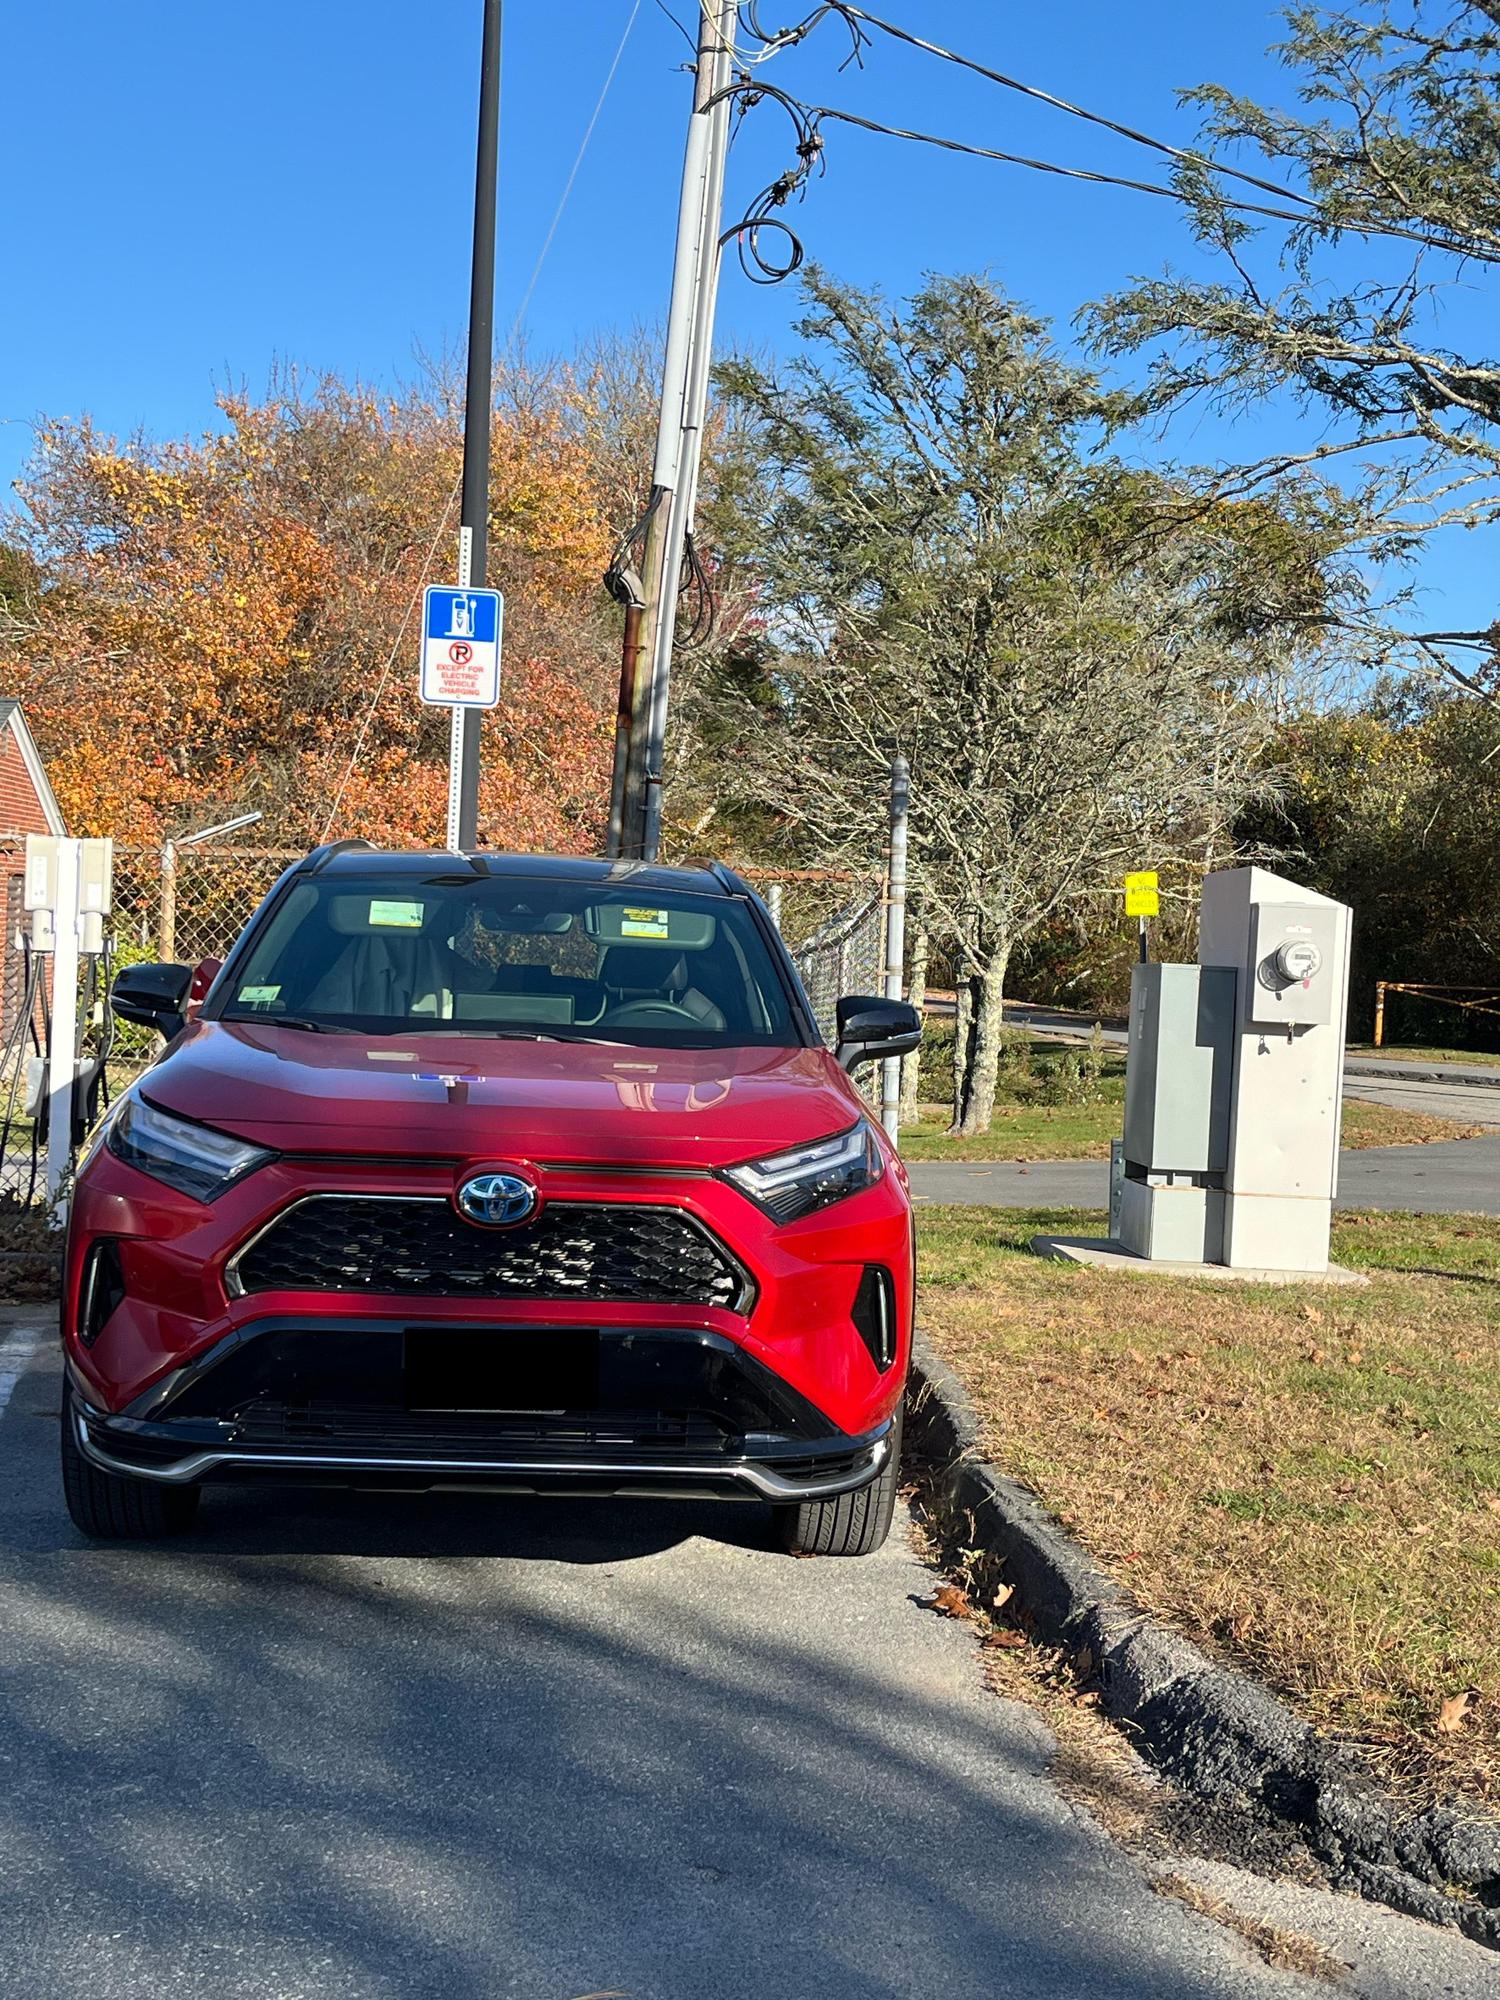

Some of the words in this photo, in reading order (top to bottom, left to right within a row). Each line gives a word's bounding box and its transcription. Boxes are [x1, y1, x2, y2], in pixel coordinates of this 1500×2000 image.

[468, 665, 484, 673] FOR
[441, 672, 479, 681] ELECTRIC
[443, 680, 476, 688] VEHICLE
[438, 687, 480, 696] CHARGING
